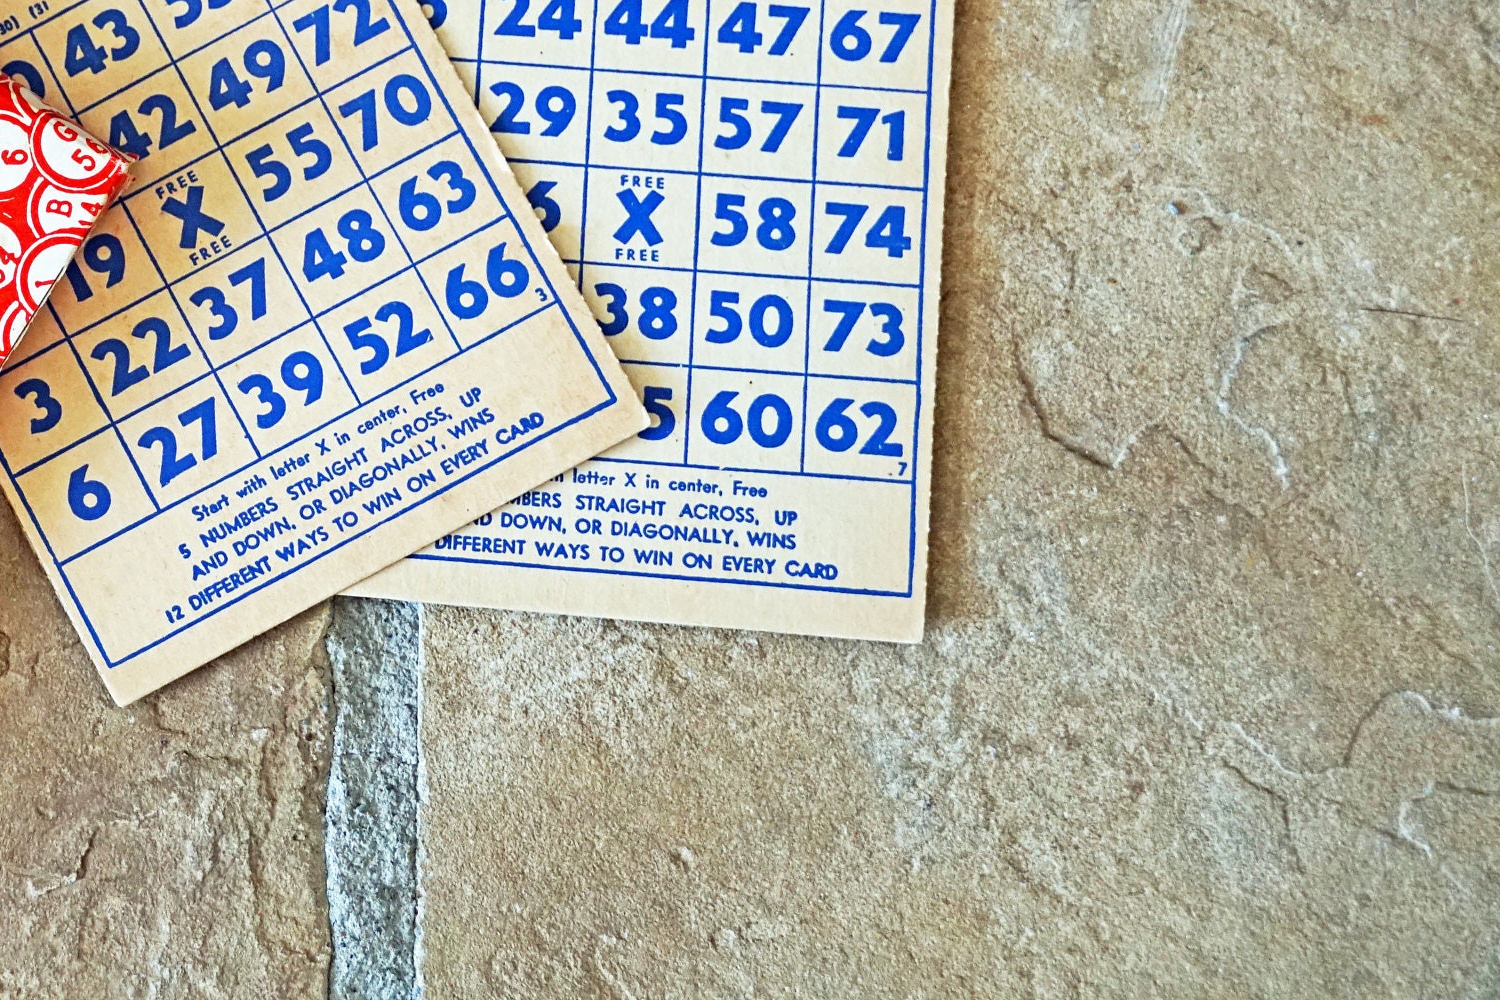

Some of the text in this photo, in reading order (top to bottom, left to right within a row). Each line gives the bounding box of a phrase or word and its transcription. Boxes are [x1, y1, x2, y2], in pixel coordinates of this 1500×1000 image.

[64, 9, 140, 77] 43
[717, 2, 811, 56] 47
[829, 10, 921, 63] 67
[209, 39, 285, 111] 49
[603, 89, 905, 161] 35 57 71
[160, 74, 432, 251] X 55 70
[620, 174, 664, 189] FREE
[613, 188, 911, 258] X 58 74
[615, 248, 659, 262] FREE
[90, 160, 476, 397] 22 37 48 63
[705, 290, 905, 357] 50 73
[14, 242, 529, 488] 3 27 39 52 66
[191, 494, 230, 522] Start
[236, 474, 267, 498] with
[269, 453, 310, 480] letter
[314, 438, 331, 456] X
[333, 432, 351, 446] in
[409, 383, 445, 405] Free
[701, 390, 903, 457] 60 62
[68, 464, 111, 521] 6
[178, 543, 191, 559] 5
[199, 496, 278, 548] NUMBERS
[286, 447, 368, 501] STRAIGHT
[459, 387, 481, 408] UP
[192, 551, 228, 581] AND
[299, 499, 327, 520] OR
[447, 408, 495, 439] WINS
[165, 412, 544, 624] 12 DIFFERENT WAYS TO WIN ON EVERY CARD
